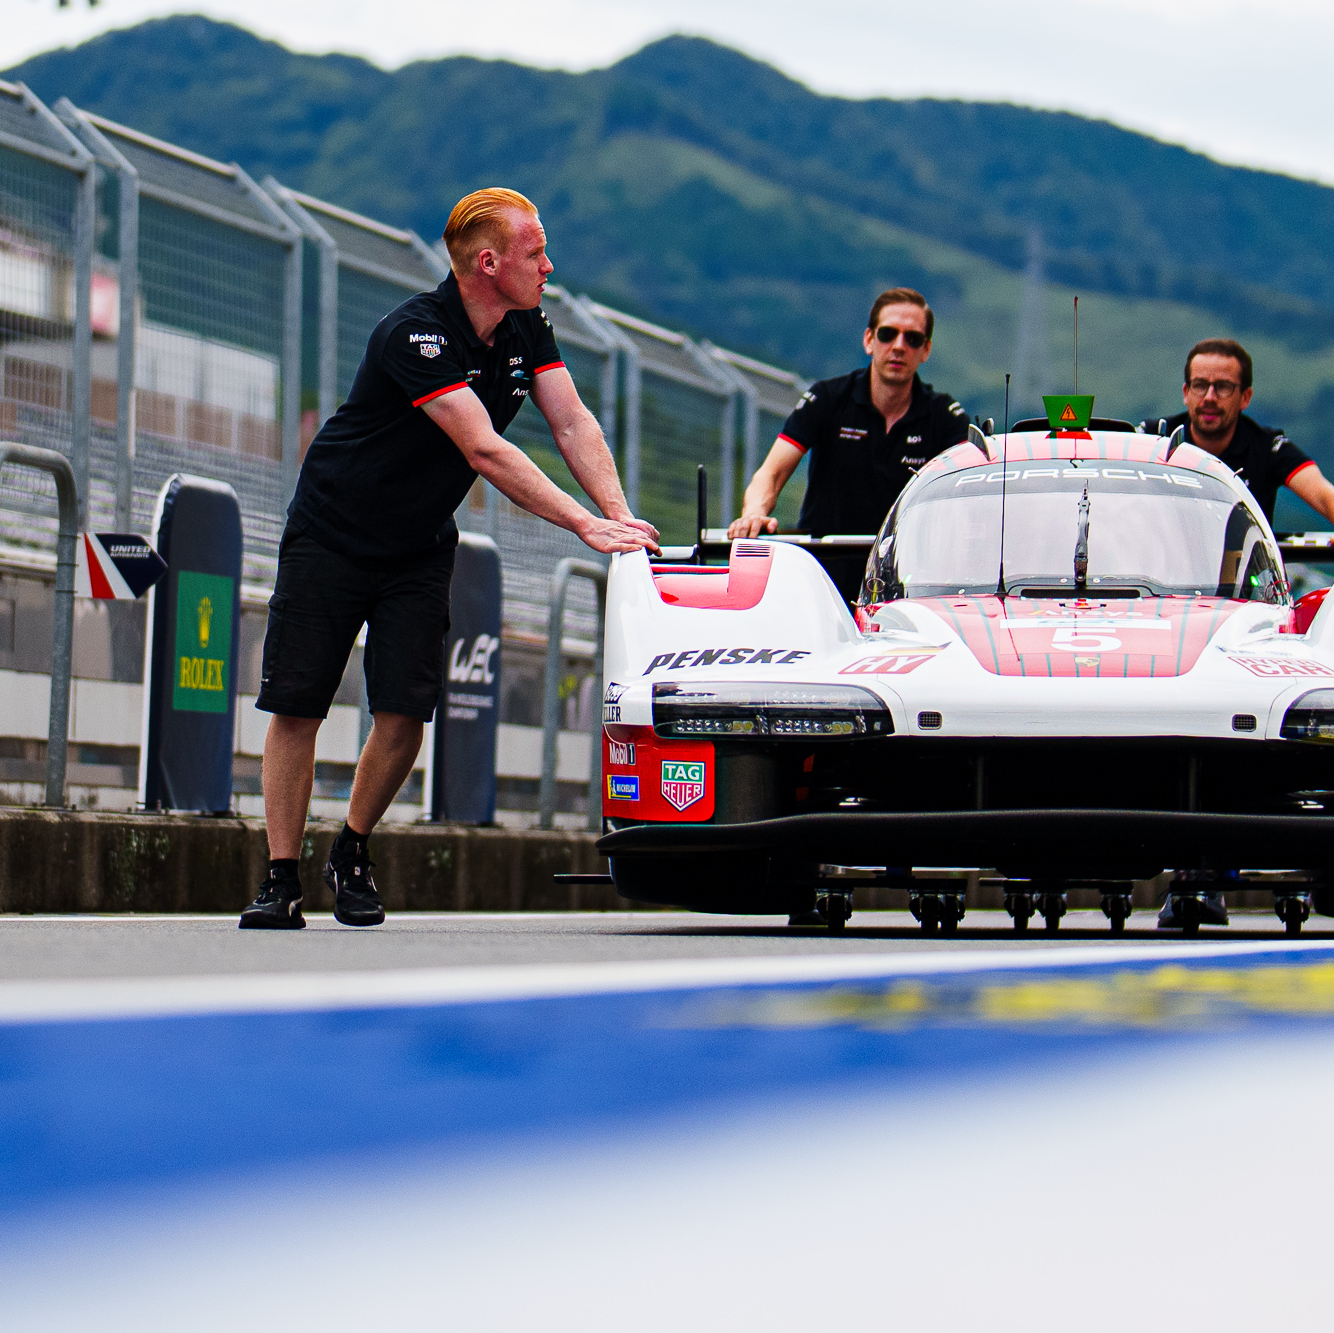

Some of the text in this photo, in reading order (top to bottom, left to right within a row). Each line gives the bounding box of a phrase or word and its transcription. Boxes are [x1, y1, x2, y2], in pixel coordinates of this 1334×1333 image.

[409, 333, 437, 343] Mobil
[509, 357, 523, 366] OSS
[512, 388, 529, 396] Ans
[903, 456, 926, 465] Ansys
[955, 468, 1203, 489] PORSCHE
[110, 546, 151, 554] UNITED
[1051, 628, 1122, 652] 5
[449, 633, 499, 684] WEC
[642, 648, 811, 676] PENSKE
[842, 656, 933, 673] HY
[179, 657, 224, 691] ROLEX
[1250, 664, 1334, 676] CAR
[609, 743, 627, 764] Mobil
[665, 765, 700, 780] TAG
[663, 783, 701, 807] HEUER
